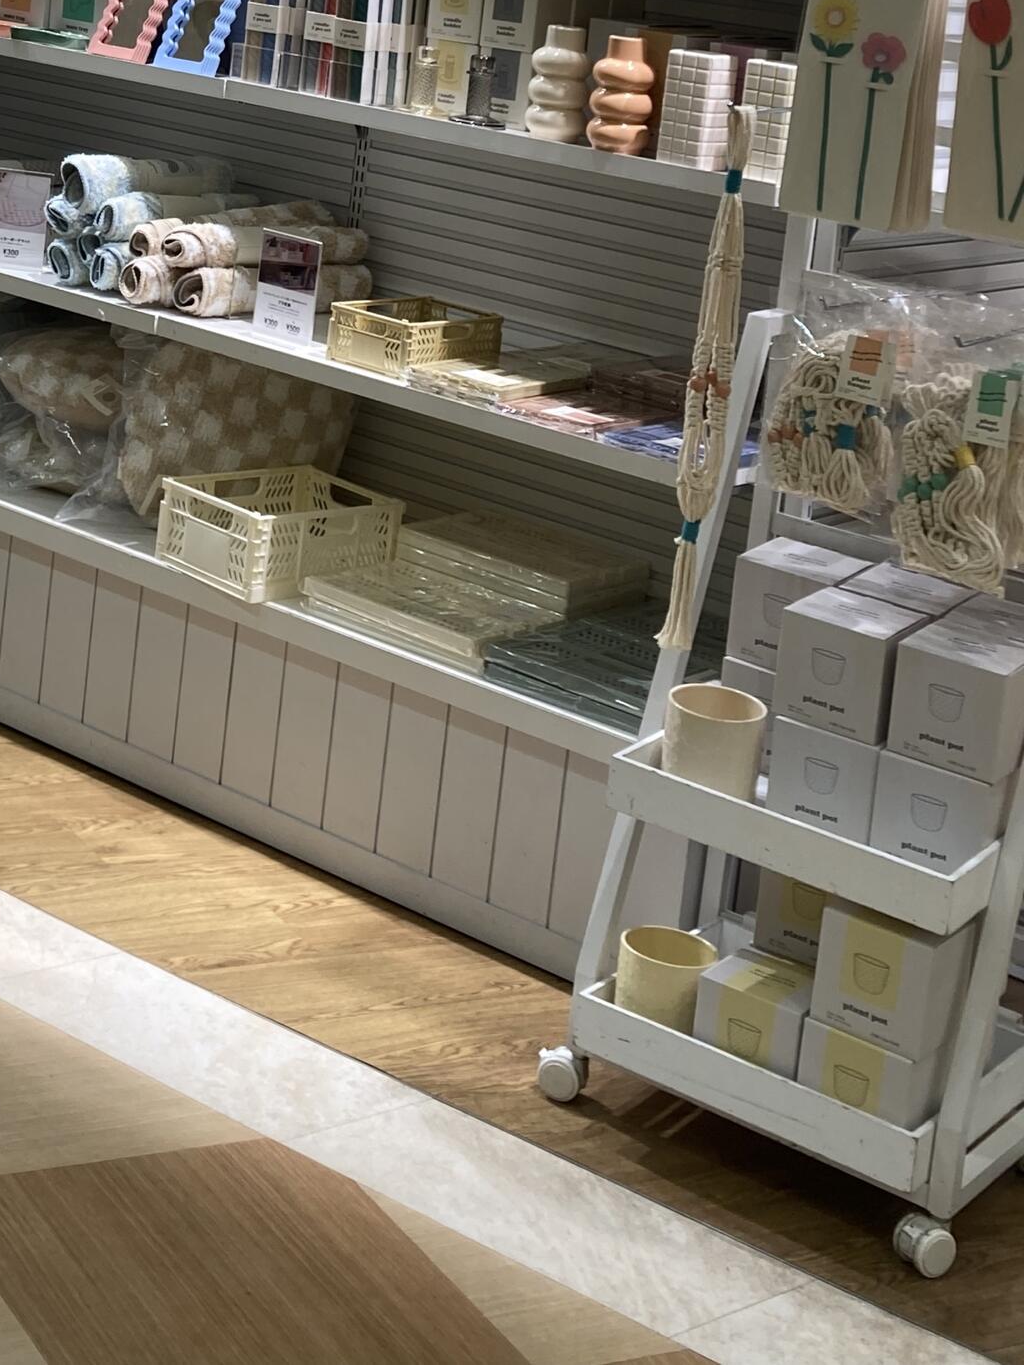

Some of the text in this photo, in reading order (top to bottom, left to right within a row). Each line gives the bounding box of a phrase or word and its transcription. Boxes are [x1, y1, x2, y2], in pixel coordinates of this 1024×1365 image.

[802, 695, 845, 714] plant pot
[918, 732, 964, 752] plant pot
[794, 803, 838, 824] plant pot
[901, 841, 947, 862] plant pot
[783, 929, 808, 943] plant
[842, 1002, 888, 1026] plant pot
